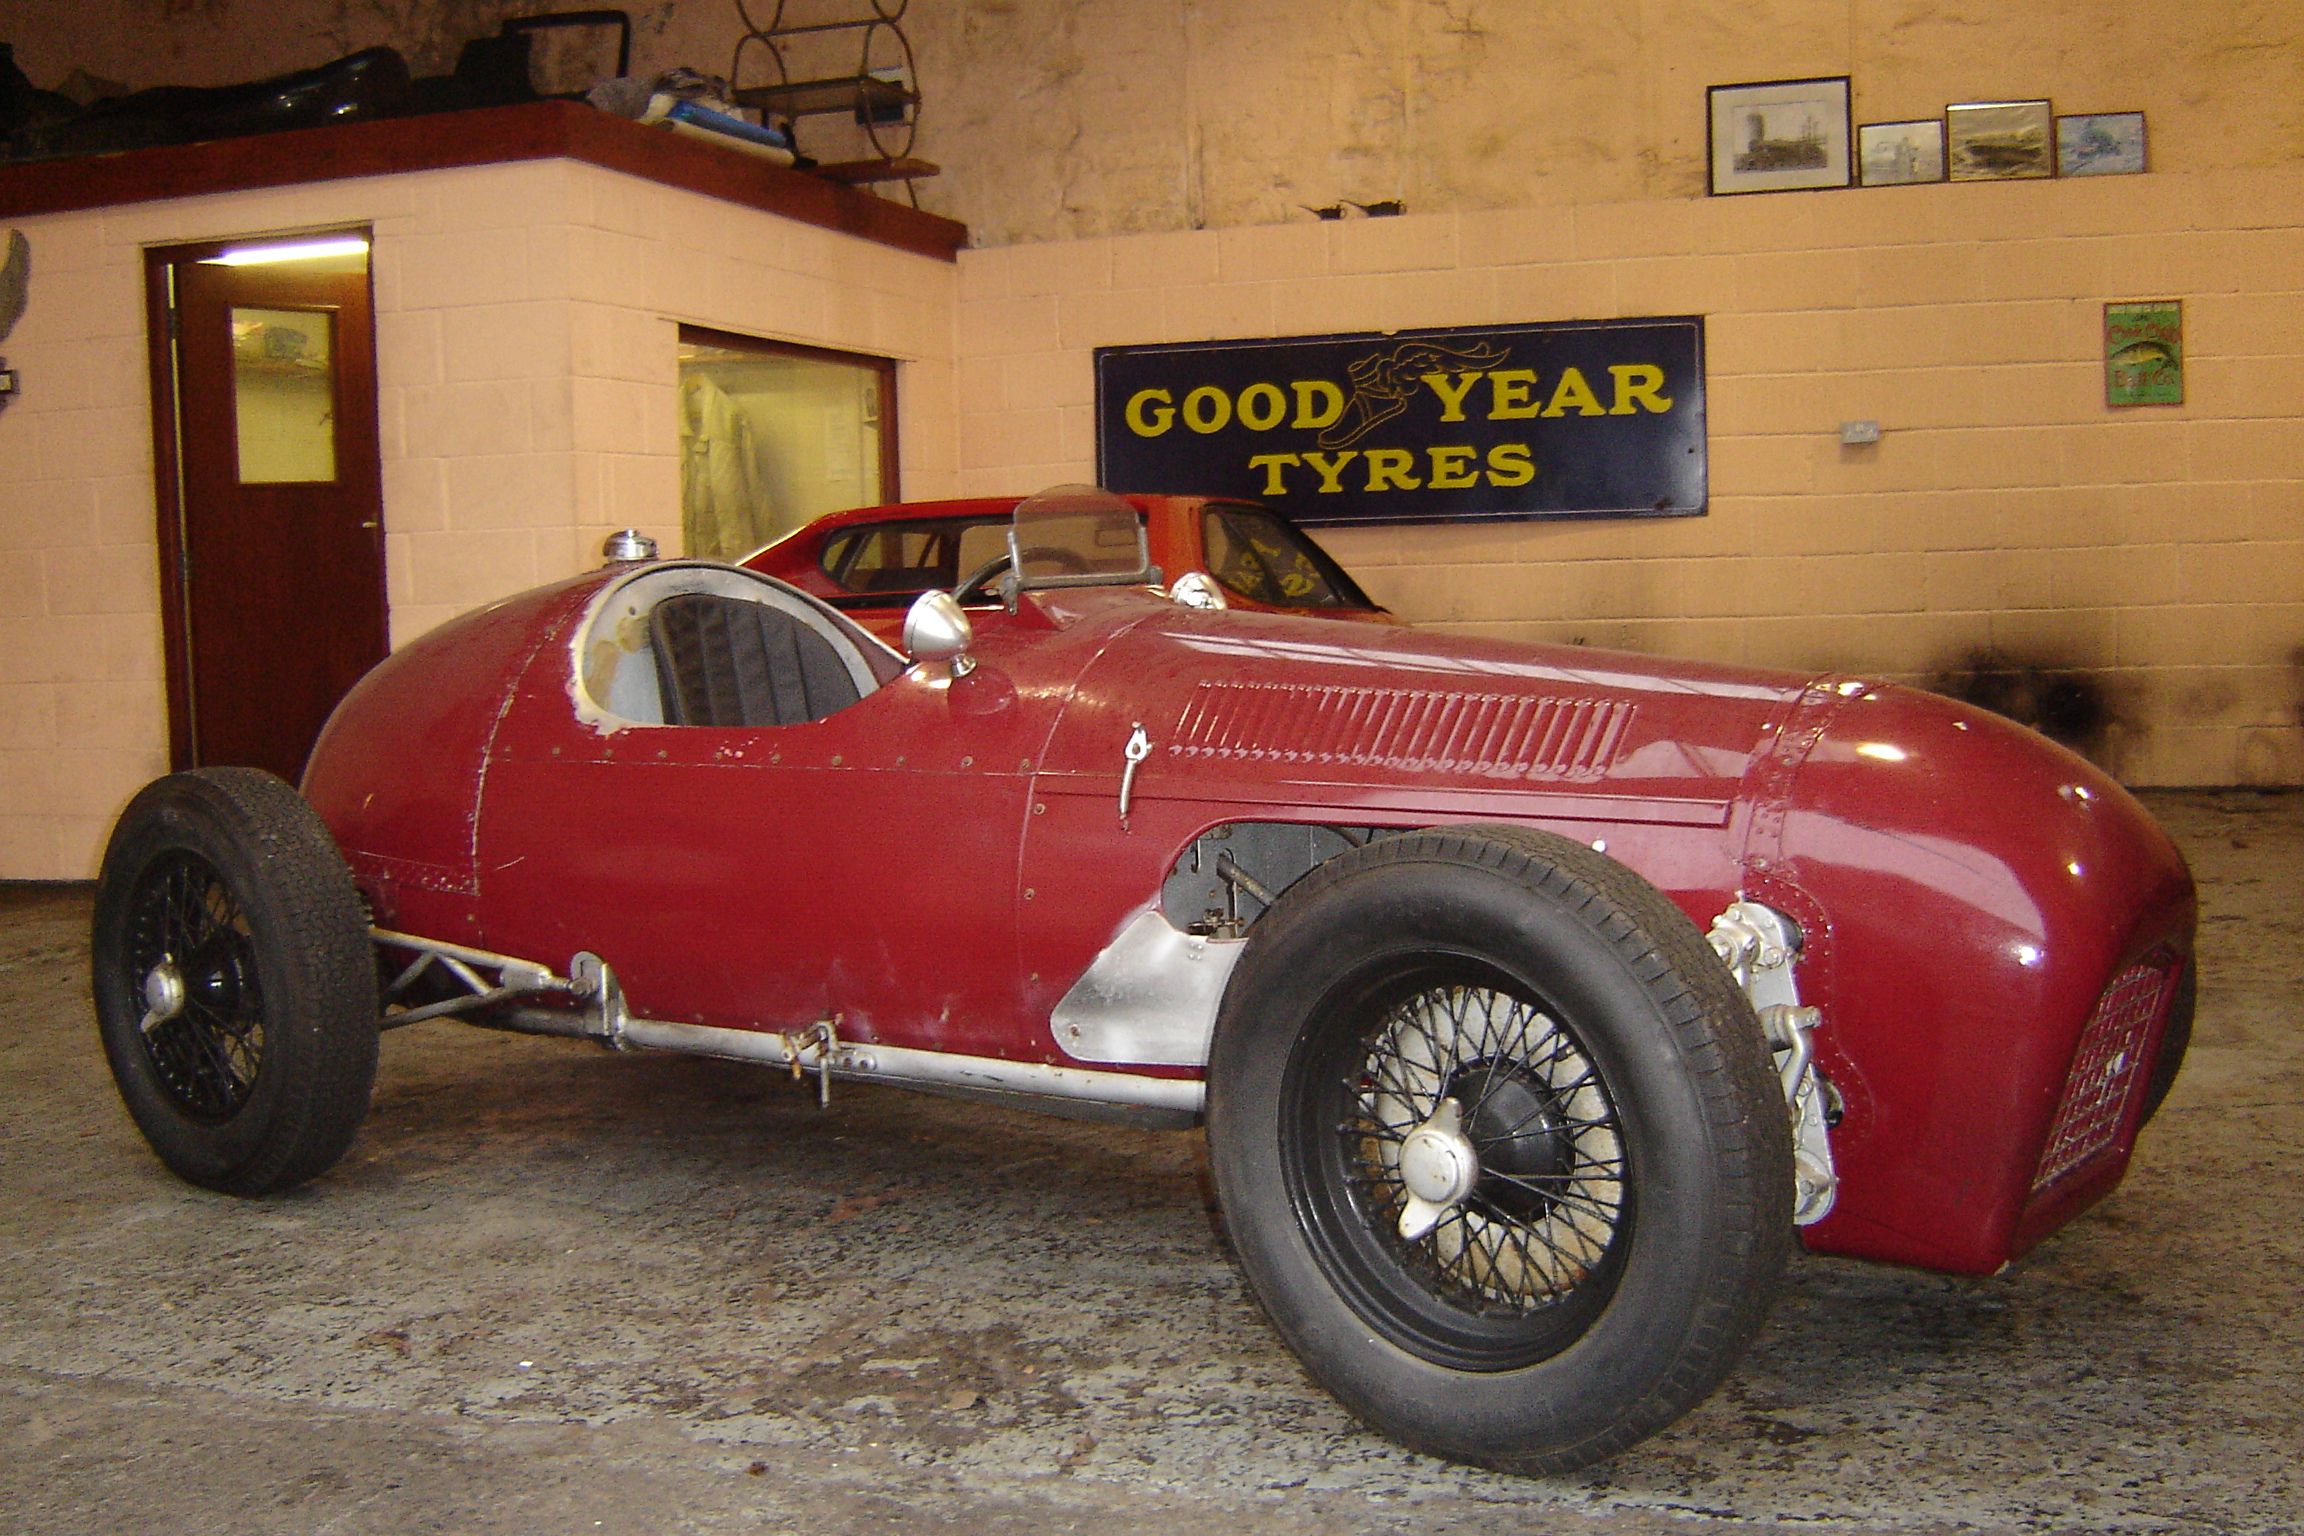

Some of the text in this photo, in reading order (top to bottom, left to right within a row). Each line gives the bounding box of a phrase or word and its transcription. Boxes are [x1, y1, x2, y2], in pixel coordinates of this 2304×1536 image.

[1125, 364, 1673, 437] GOOD YEAR
[1248, 444, 1535, 495] TYRES
